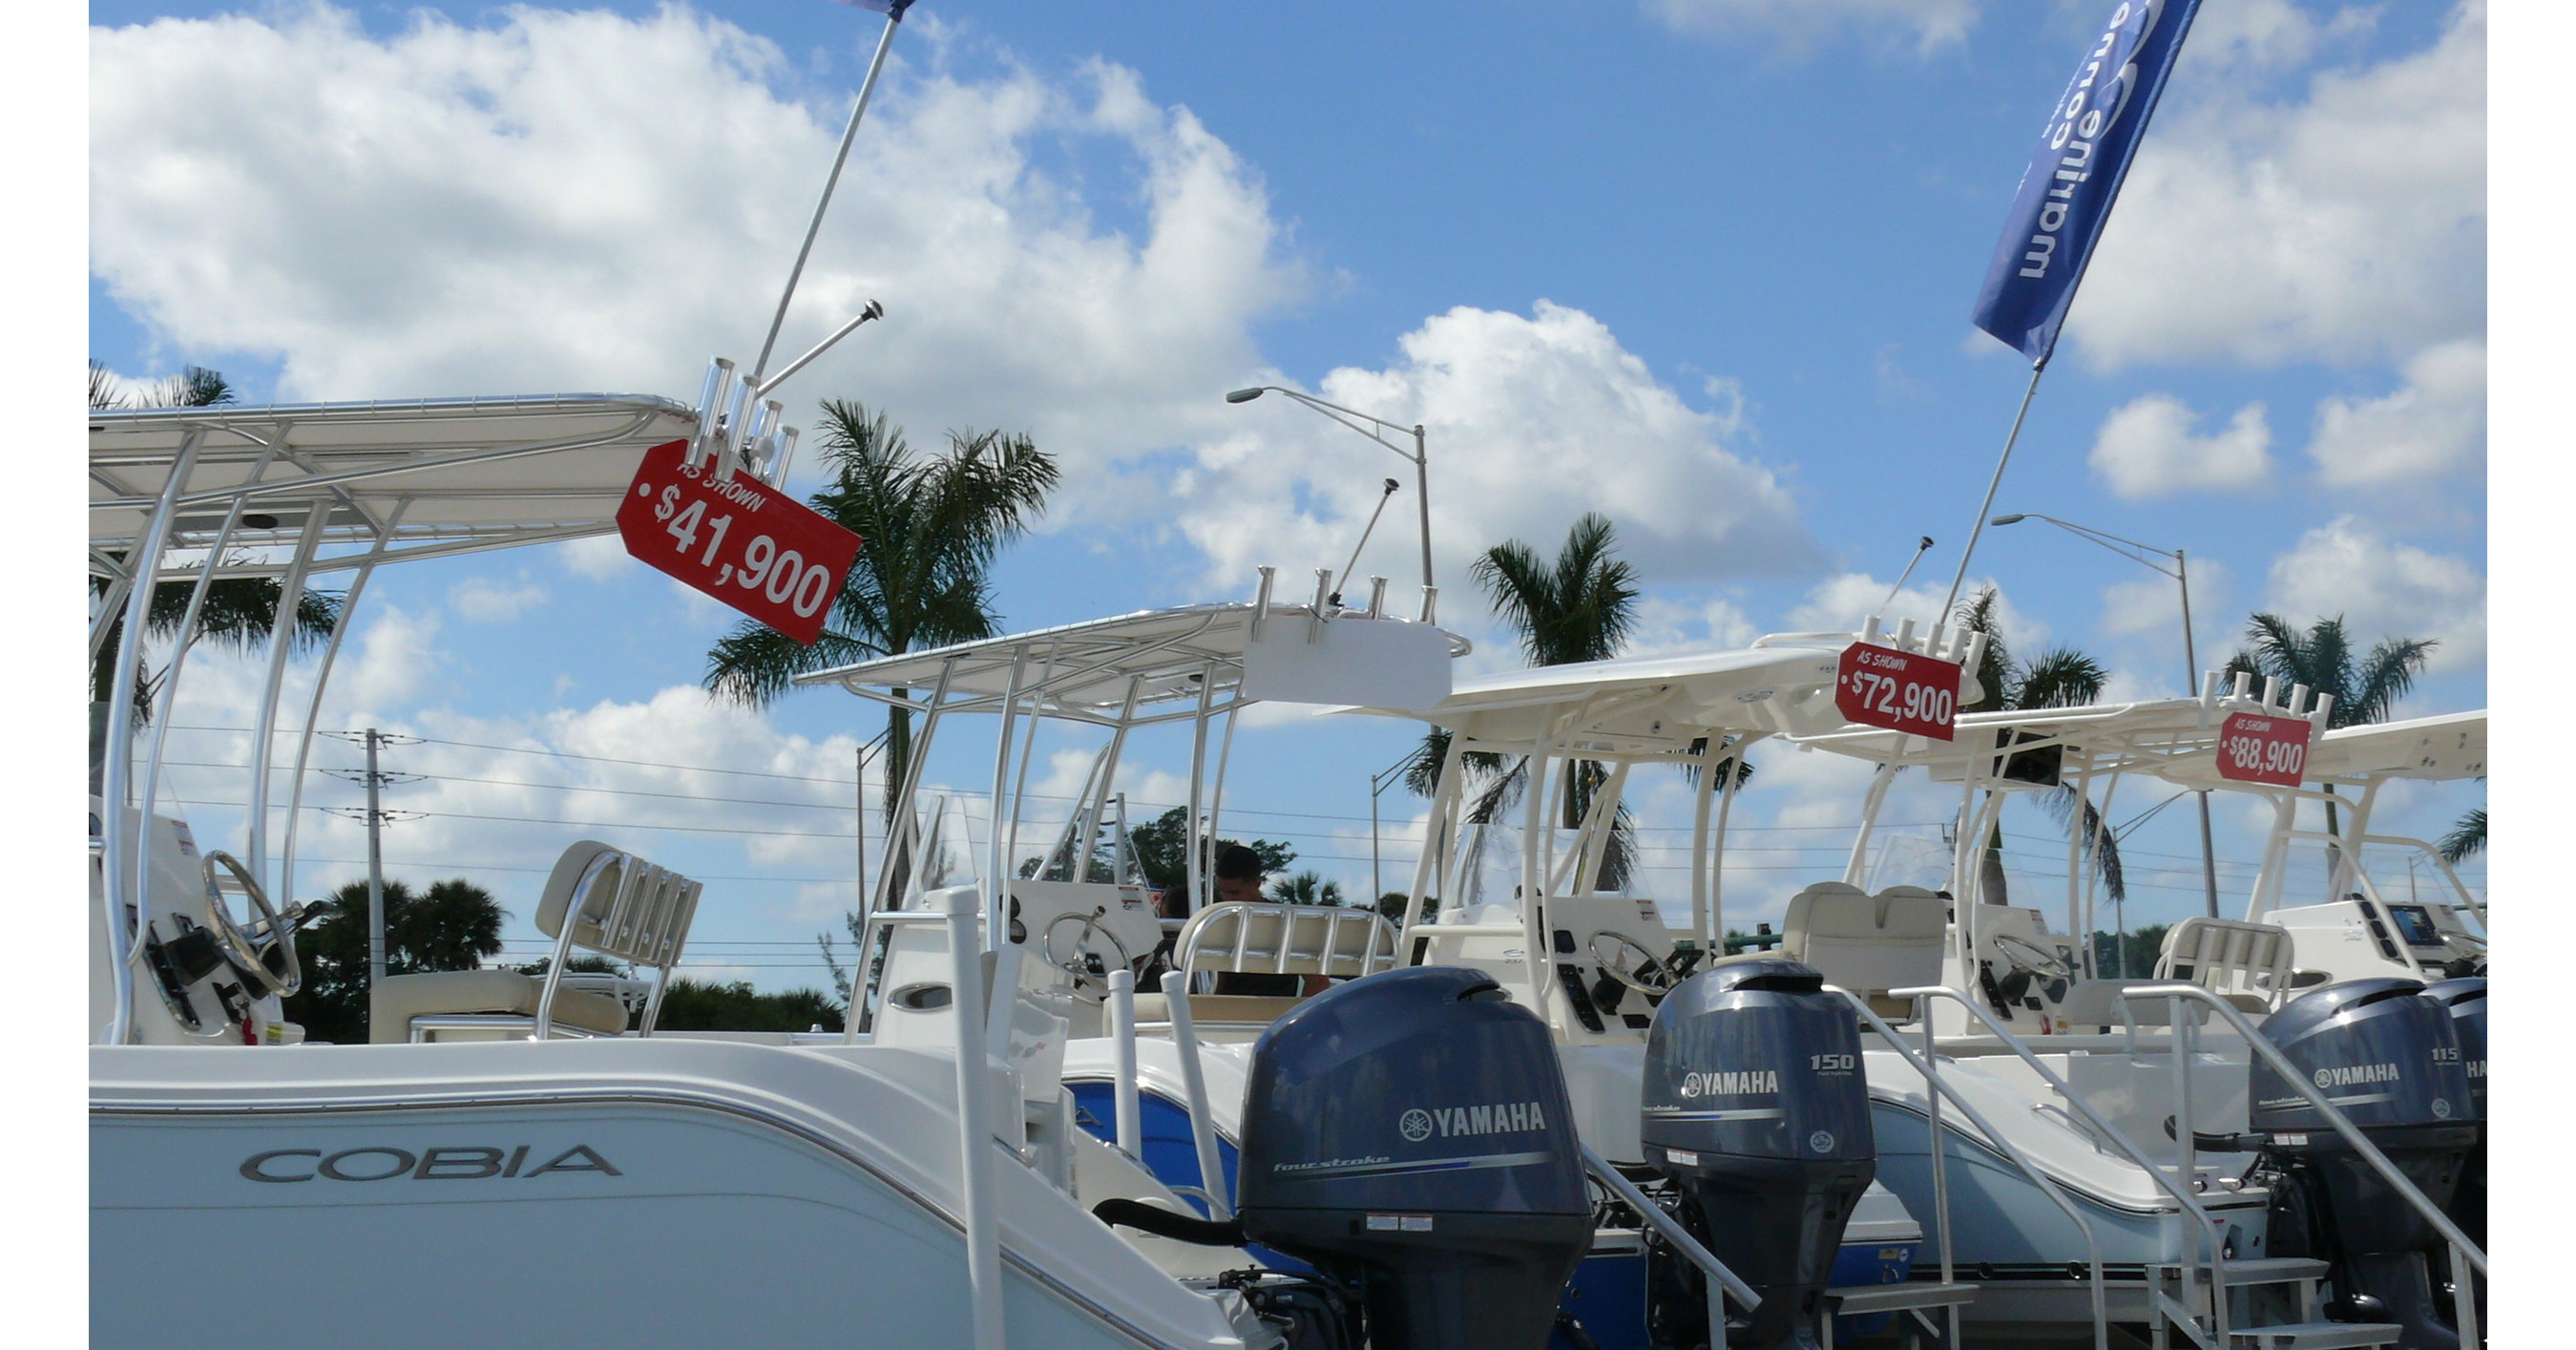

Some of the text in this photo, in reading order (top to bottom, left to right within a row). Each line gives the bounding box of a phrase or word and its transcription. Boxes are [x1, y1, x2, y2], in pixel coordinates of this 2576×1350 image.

[654, 483, 830, 619] $41,900
[1856, 650, 1908, 672] AS SHOWN
[1852, 670, 1953, 726] $72,900
[2229, 735, 2303, 776] $88,900
[1810, 1054, 1855, 1070] 150
[2431, 1047, 2459, 1061] 115
[1702, 1070, 1779, 1096] YAMAHA
[2331, 1063, 2400, 1086] YAMAHA
[1434, 1101, 1546, 1138] YAMAHA
[239, 1144, 624, 1184] COBIA
